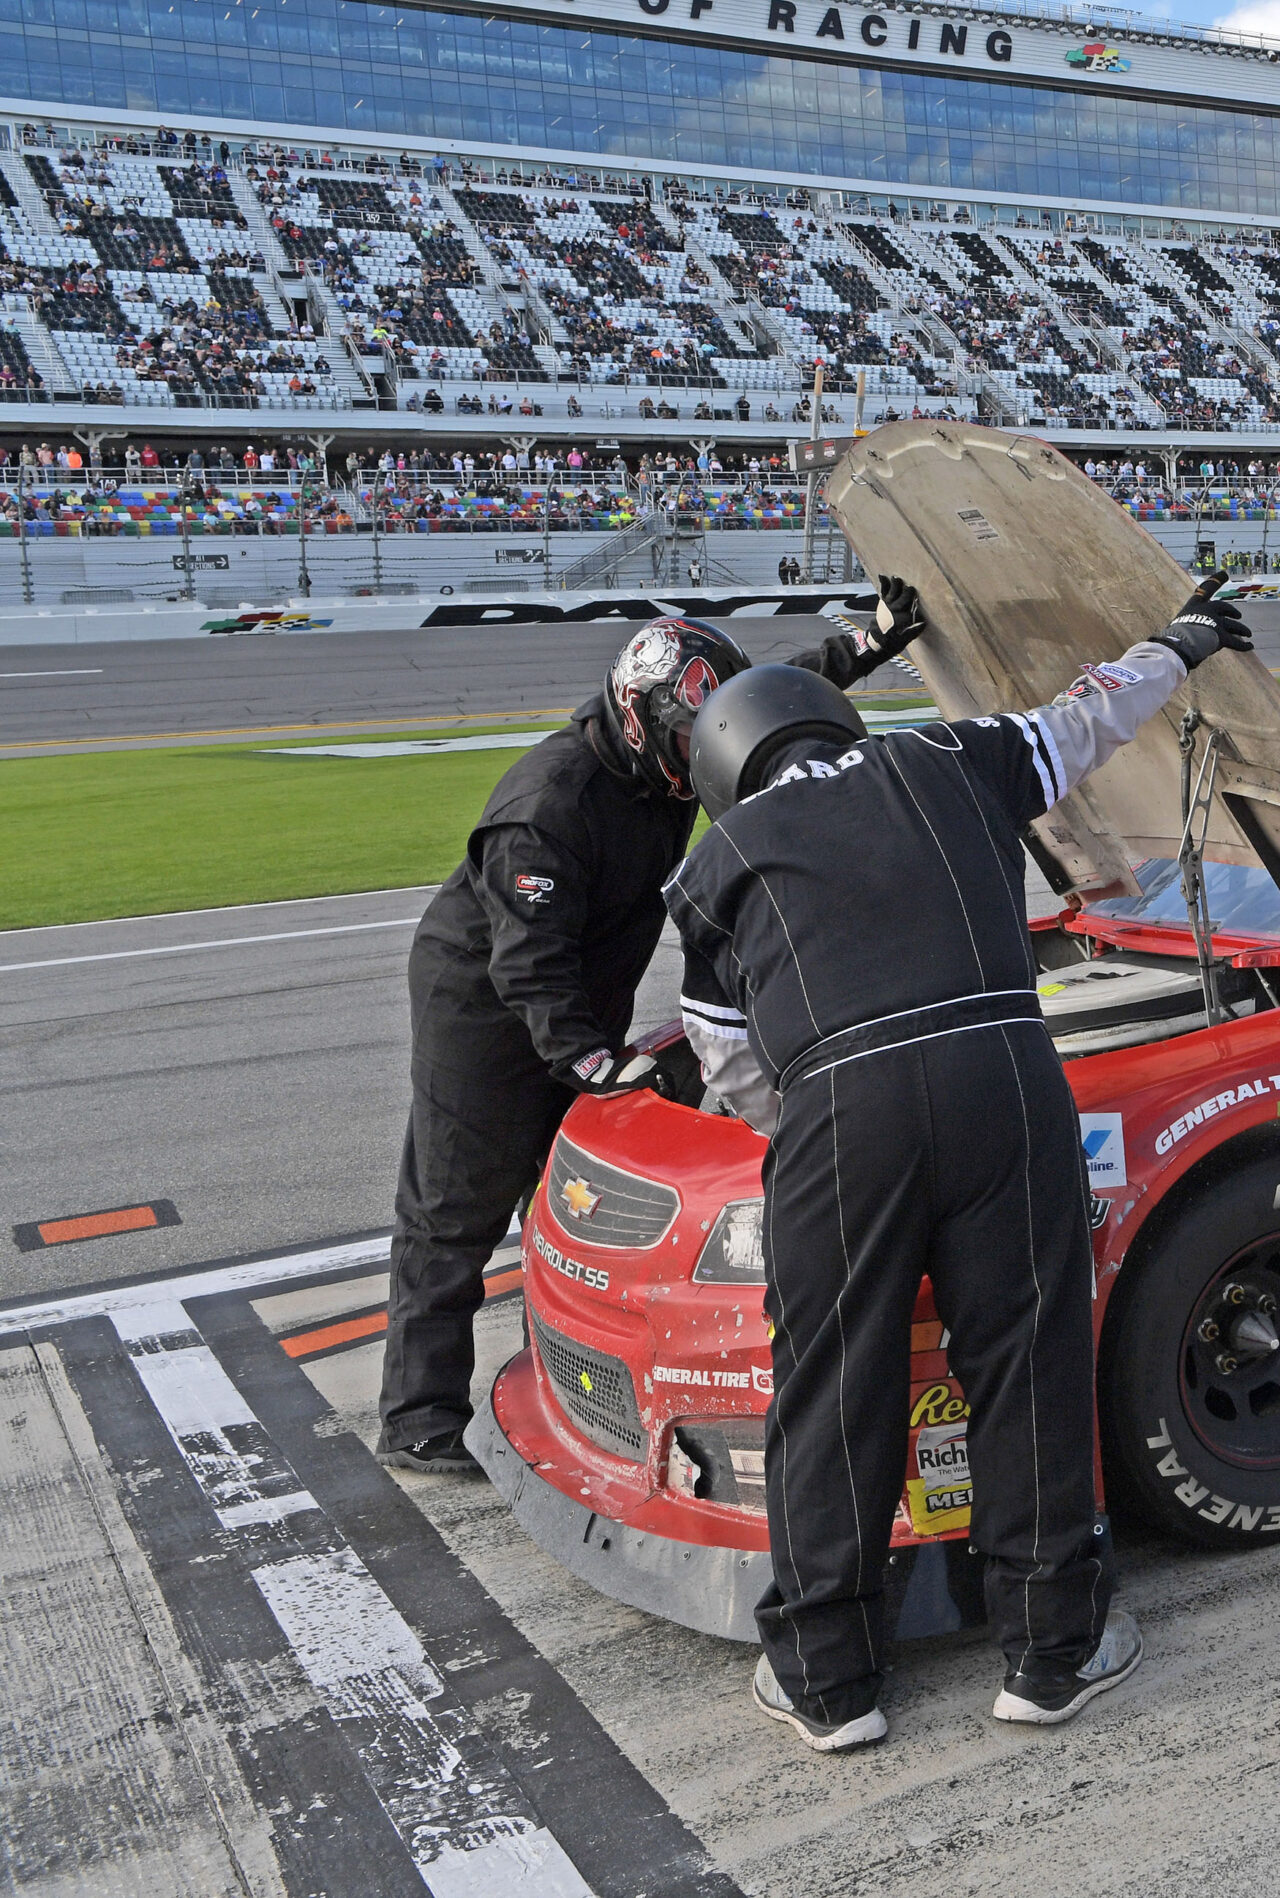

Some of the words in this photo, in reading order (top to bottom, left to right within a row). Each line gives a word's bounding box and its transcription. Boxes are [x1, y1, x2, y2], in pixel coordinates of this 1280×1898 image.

[768, 0, 1013, 62] RACING
[366, 213, 381, 224] 352
[189, 562, 216, 570] ECTIONS
[1155, 1078, 1270, 1155] GENERAL
[533, 1224, 584, 1281] CHEVROLET
[584, 1267, 610, 1291] SS
[652, 1364, 711, 1387] GENERAL
[711, 1371, 750, 1388] TIRE
[918, 1443, 968, 1470] Rich
[938, 1467, 952, 1477] The
